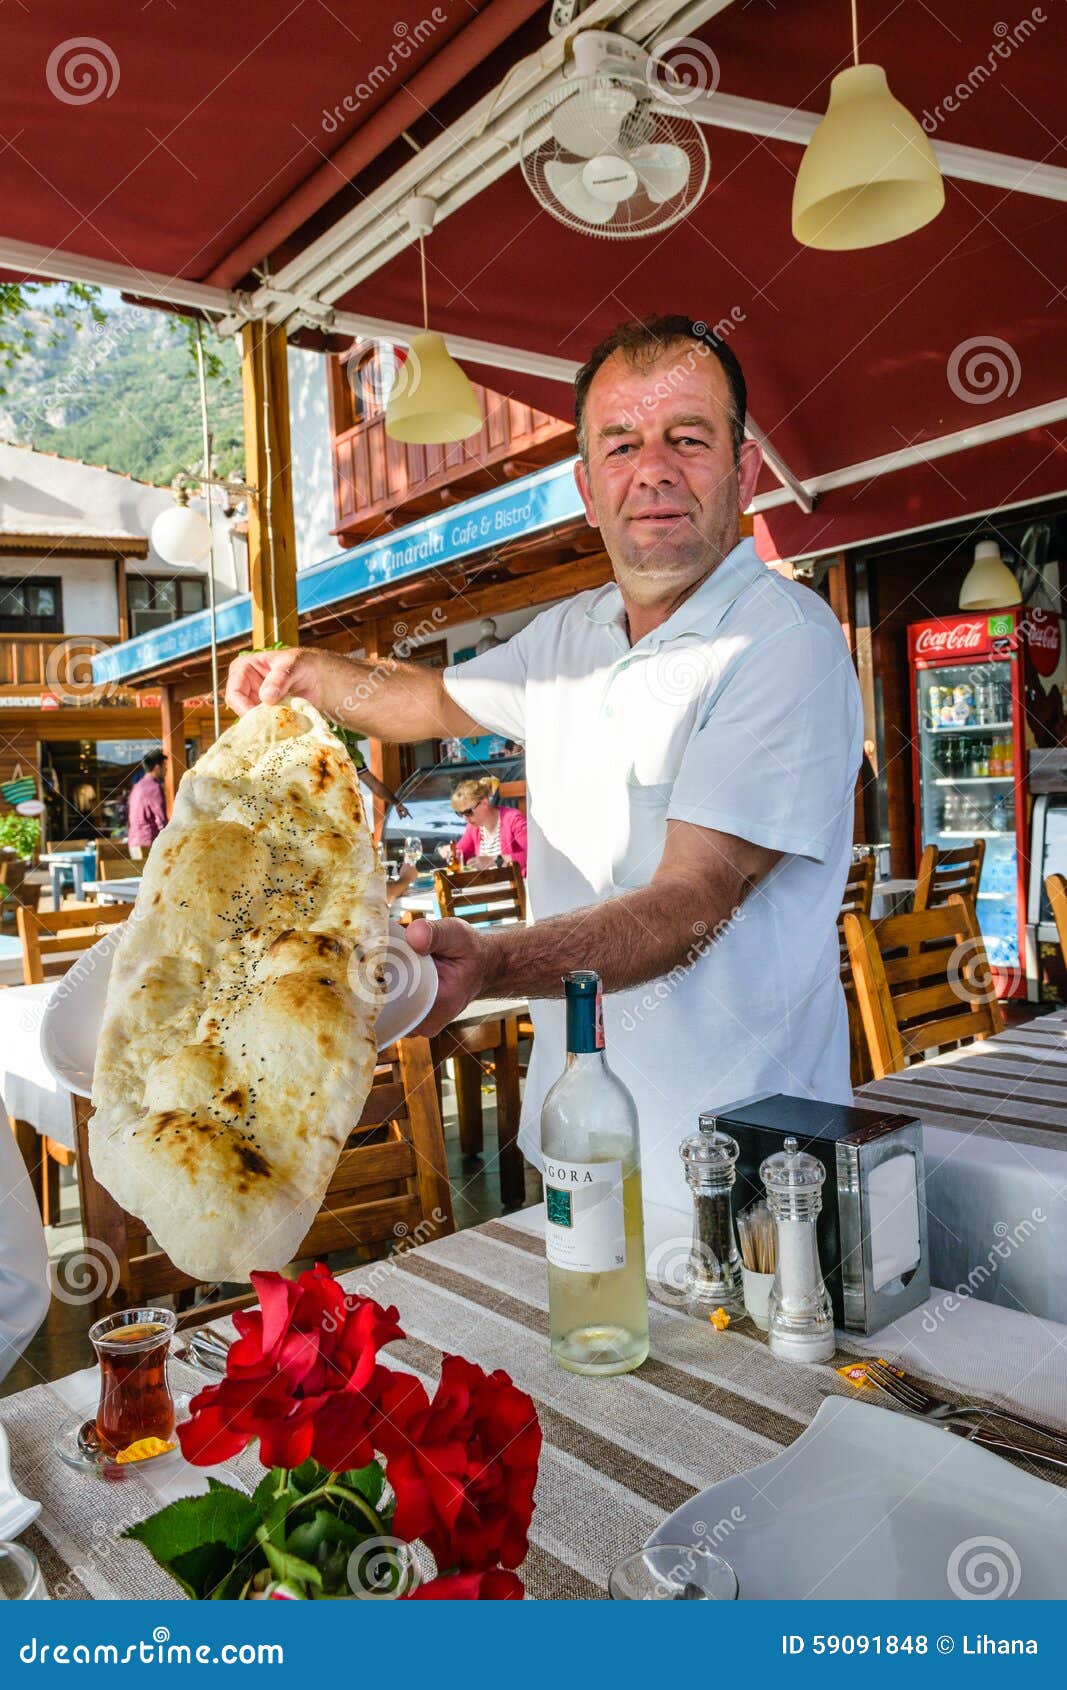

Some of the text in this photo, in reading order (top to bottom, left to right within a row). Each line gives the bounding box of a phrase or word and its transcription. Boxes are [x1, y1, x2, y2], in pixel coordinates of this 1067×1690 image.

[451, 520, 478, 546] Cafe
[480, 516, 493, 535] &
[495, 504, 532, 530] Bistro
